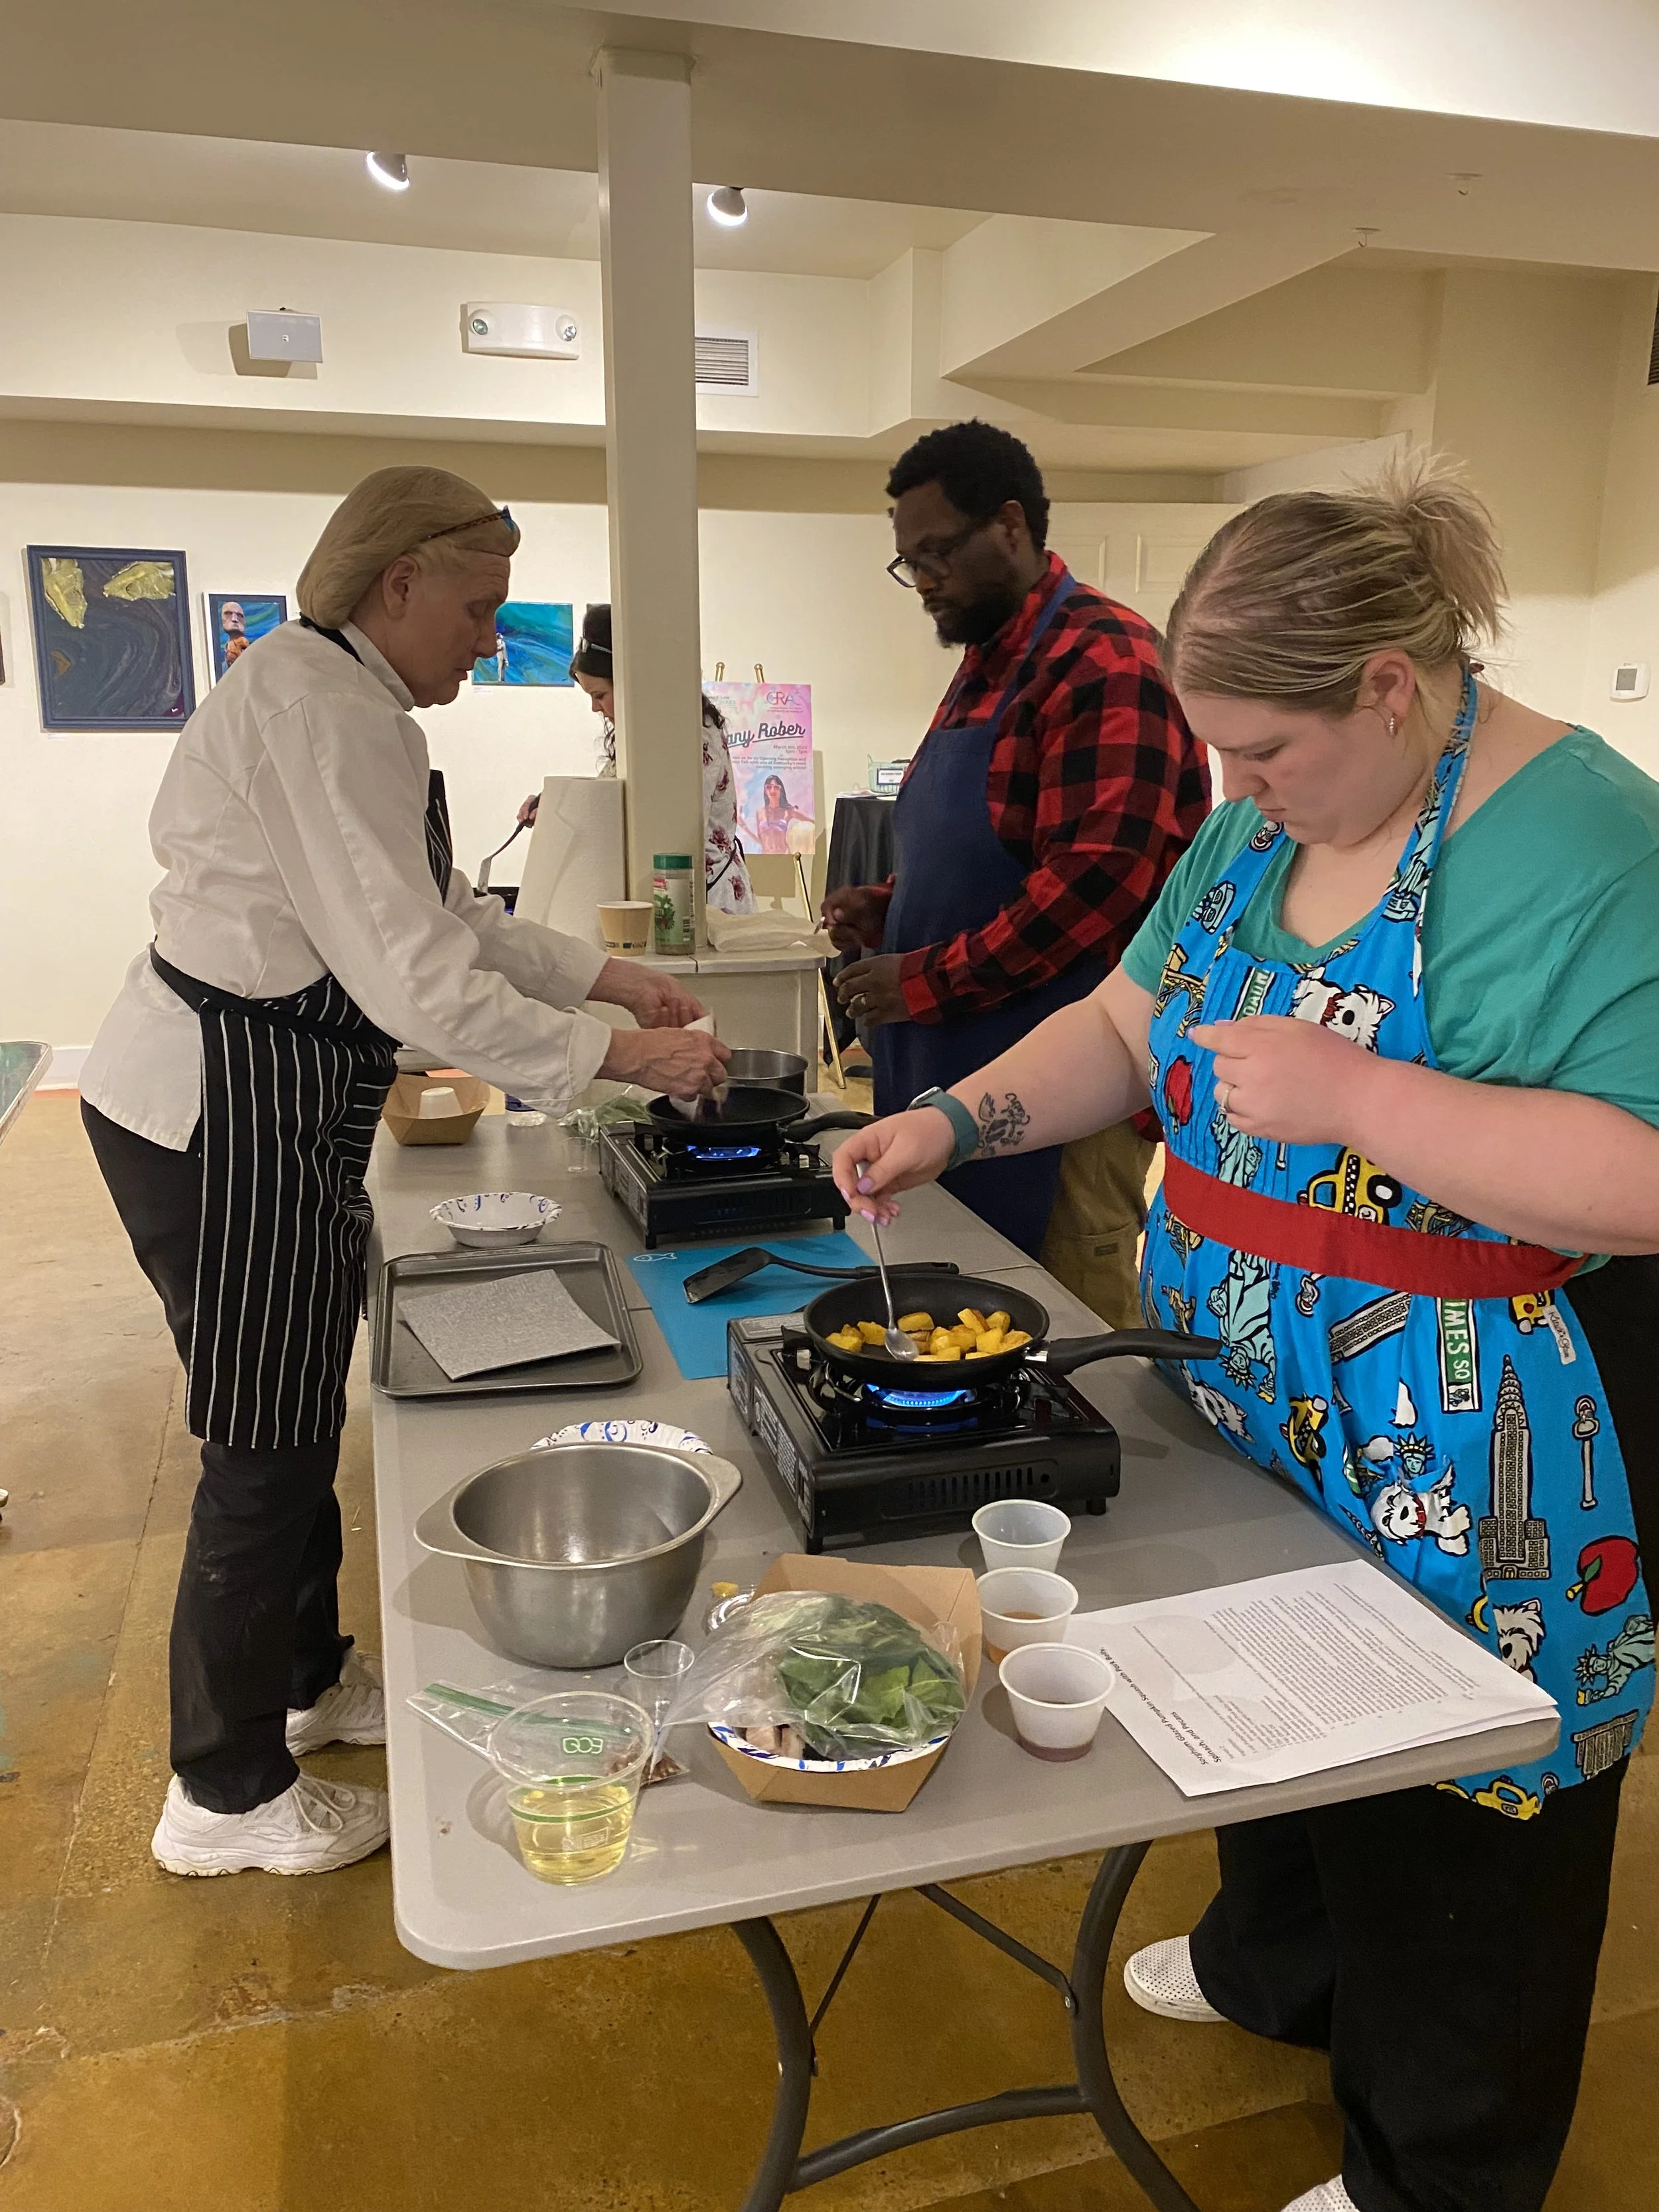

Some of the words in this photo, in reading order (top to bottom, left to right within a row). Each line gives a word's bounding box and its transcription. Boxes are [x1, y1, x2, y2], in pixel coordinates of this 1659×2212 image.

[727, 730, 755, 748] any
[758, 721, 806, 739] Rober
[1444, 1301, 1469, 1355] IMES
[1453, 1359, 1470, 1380] SQ
[1110, 1660, 1122, 1672] Pork
[1119, 1671, 1133, 1684] with
[1130, 1682, 1149, 1701] Squash
[1146, 1701, 1169, 1725] Pumpkin
[1170, 1711, 1191, 1730] Pecans
[1166, 1724, 1185, 1741] Glazed
[1187, 1729, 1200, 1740] and
[1183, 1741, 1209, 1765] Sorghum
[1198, 1739, 1222, 1763] Spinach,
